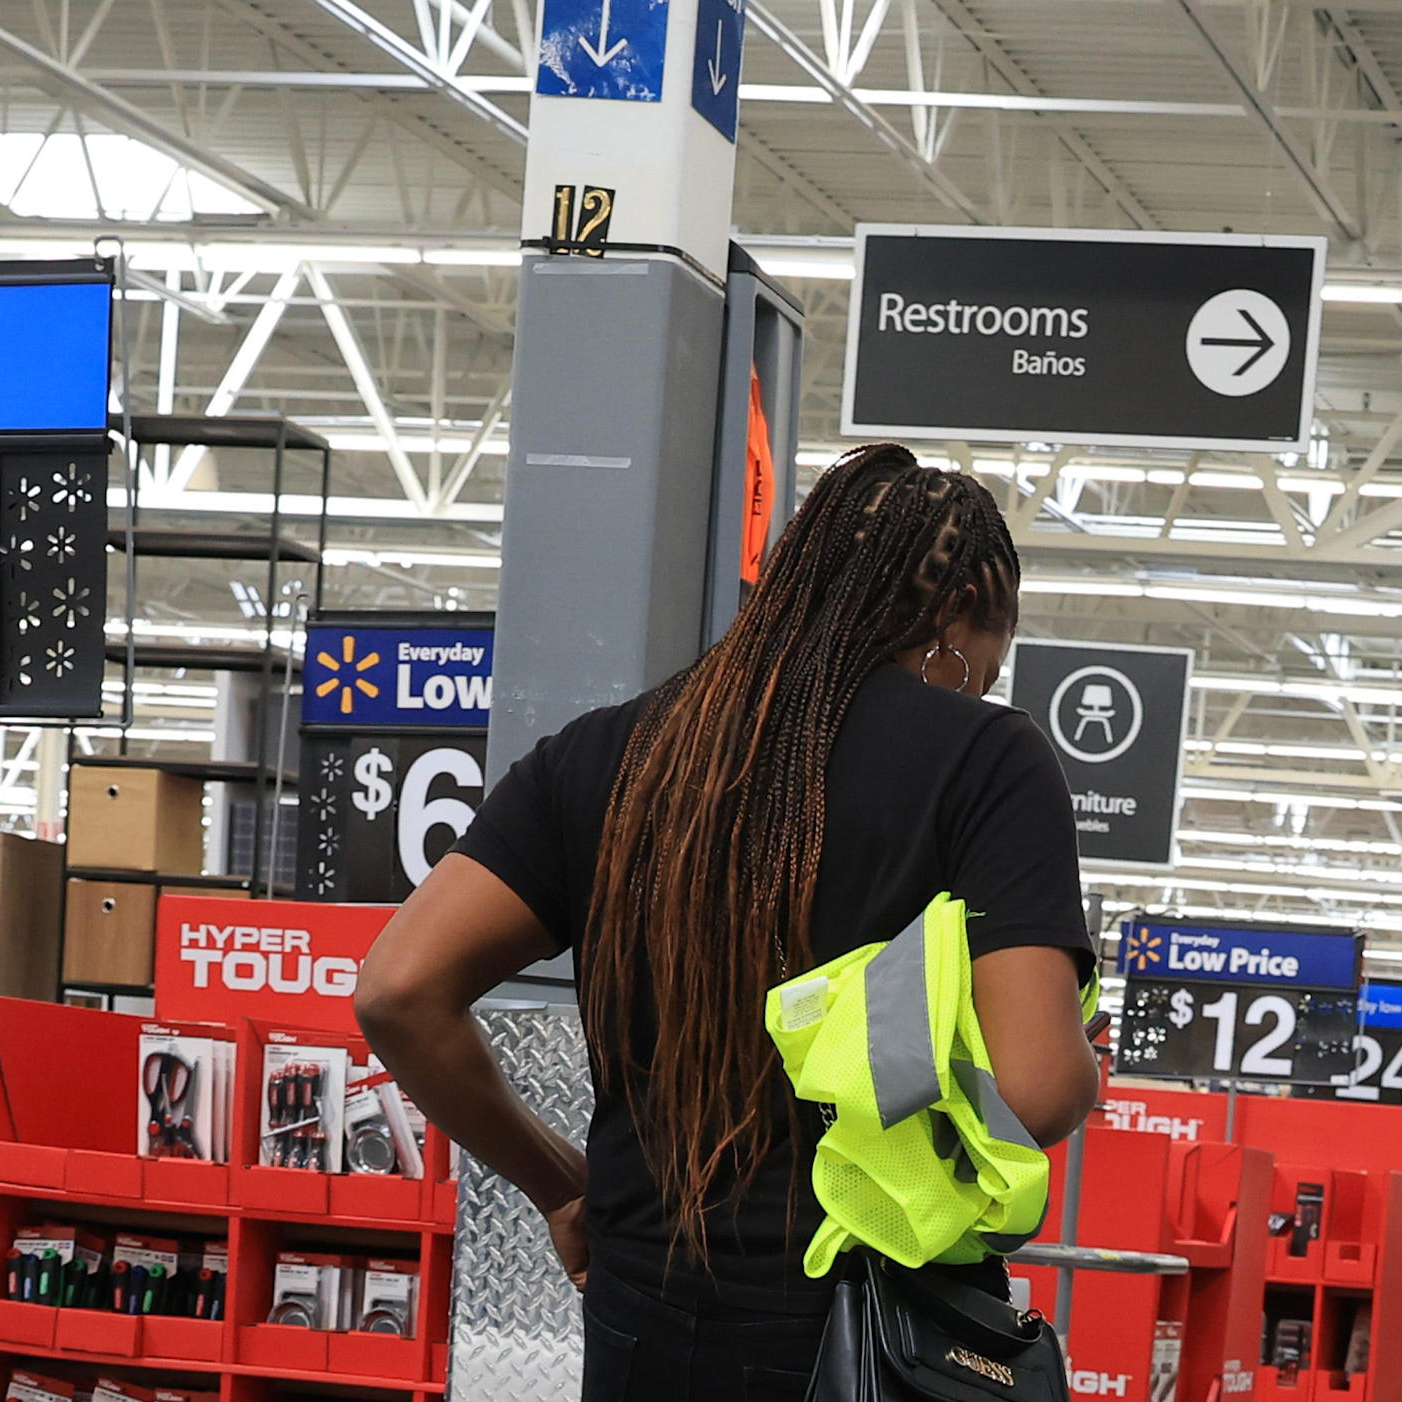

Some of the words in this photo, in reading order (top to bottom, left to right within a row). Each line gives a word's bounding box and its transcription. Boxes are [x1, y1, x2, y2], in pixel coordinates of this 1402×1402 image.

[553, 187, 614, 257] 12
[878, 293, 1089, 340] Restrooms
[1012, 348, 1086, 377] Baños
[398, 642, 485, 666] Everyday
[396, 663, 495, 710] Low
[180, 923, 312, 954] HYPER
[180, 948, 365, 998] TOUG
[1168, 945, 1227, 973] Low
[1230, 947, 1299, 978] Price
[1379, 1001, 1402, 1014] low
[949, 1346, 1015, 1387] GUESS
